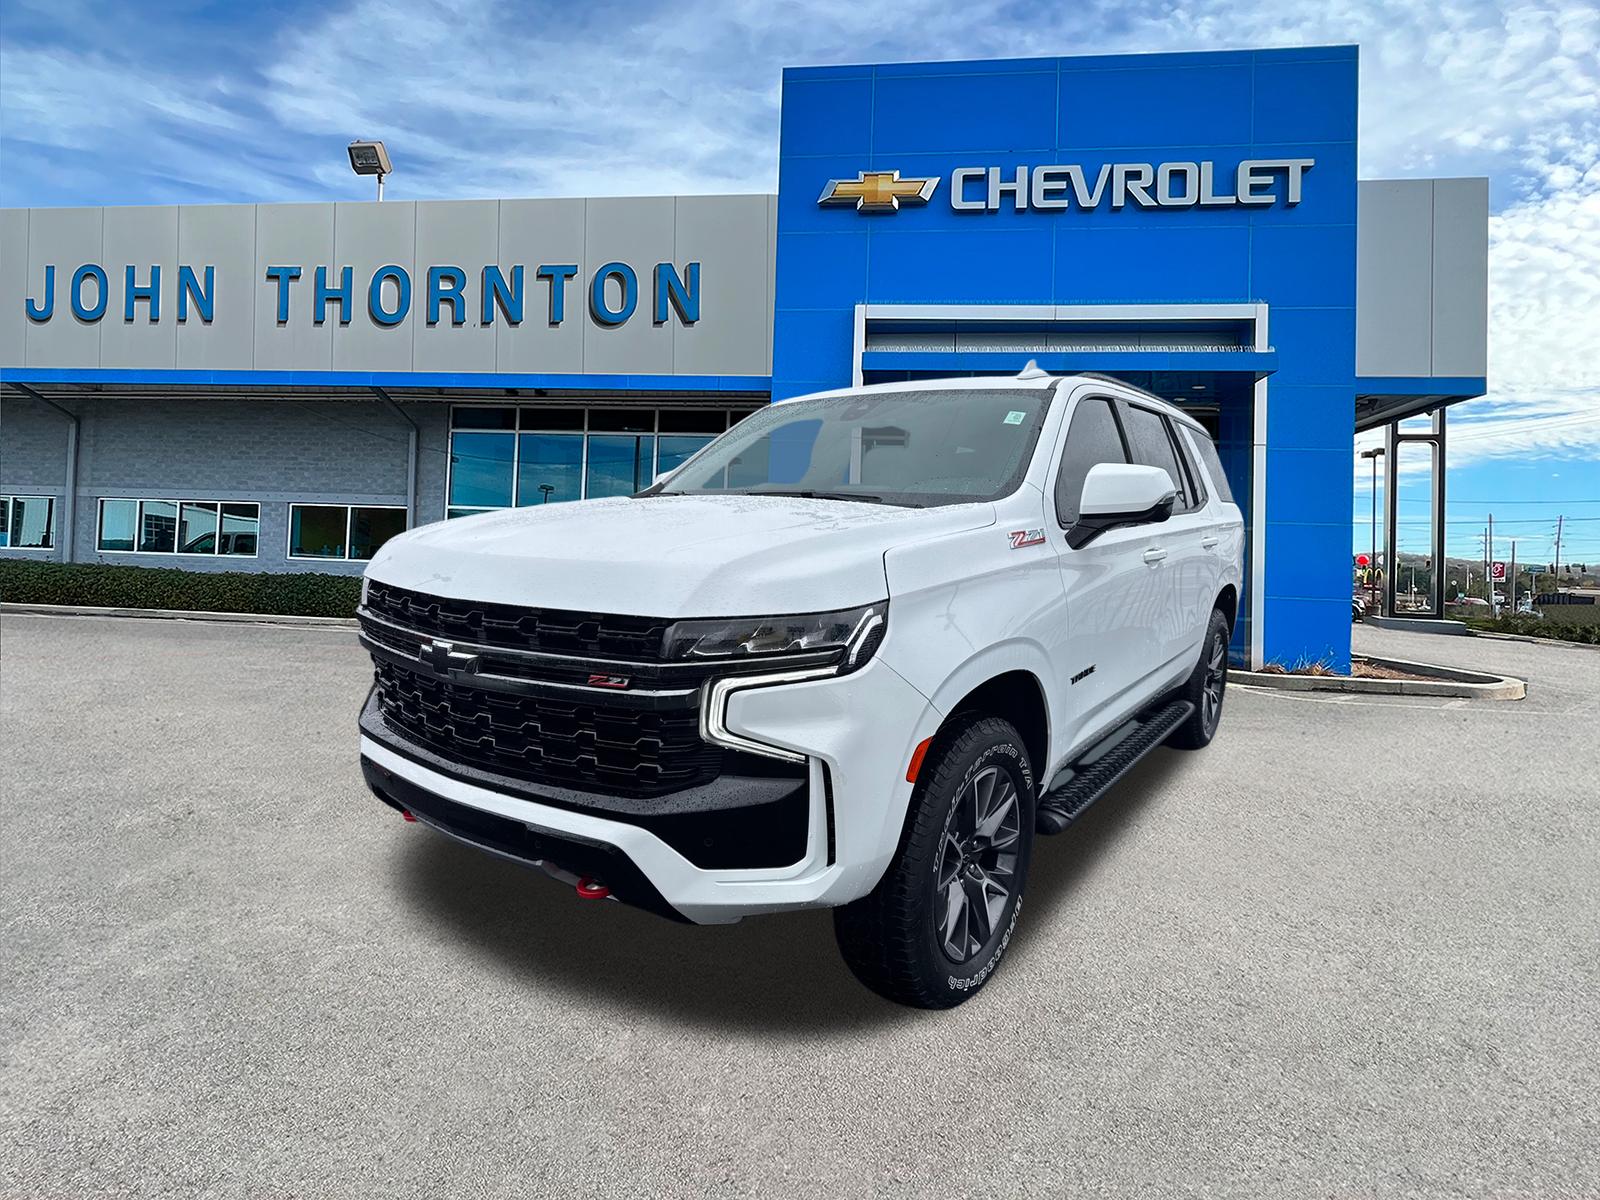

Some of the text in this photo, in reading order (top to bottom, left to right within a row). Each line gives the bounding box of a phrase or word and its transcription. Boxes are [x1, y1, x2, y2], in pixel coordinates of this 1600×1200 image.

[950, 158, 1315, 211] CHEVROLET
[26, 261, 702, 328] JOHN THORNTON
[1007, 528, 1047, 550] Z71
[587, 673, 631, 689] Z71
